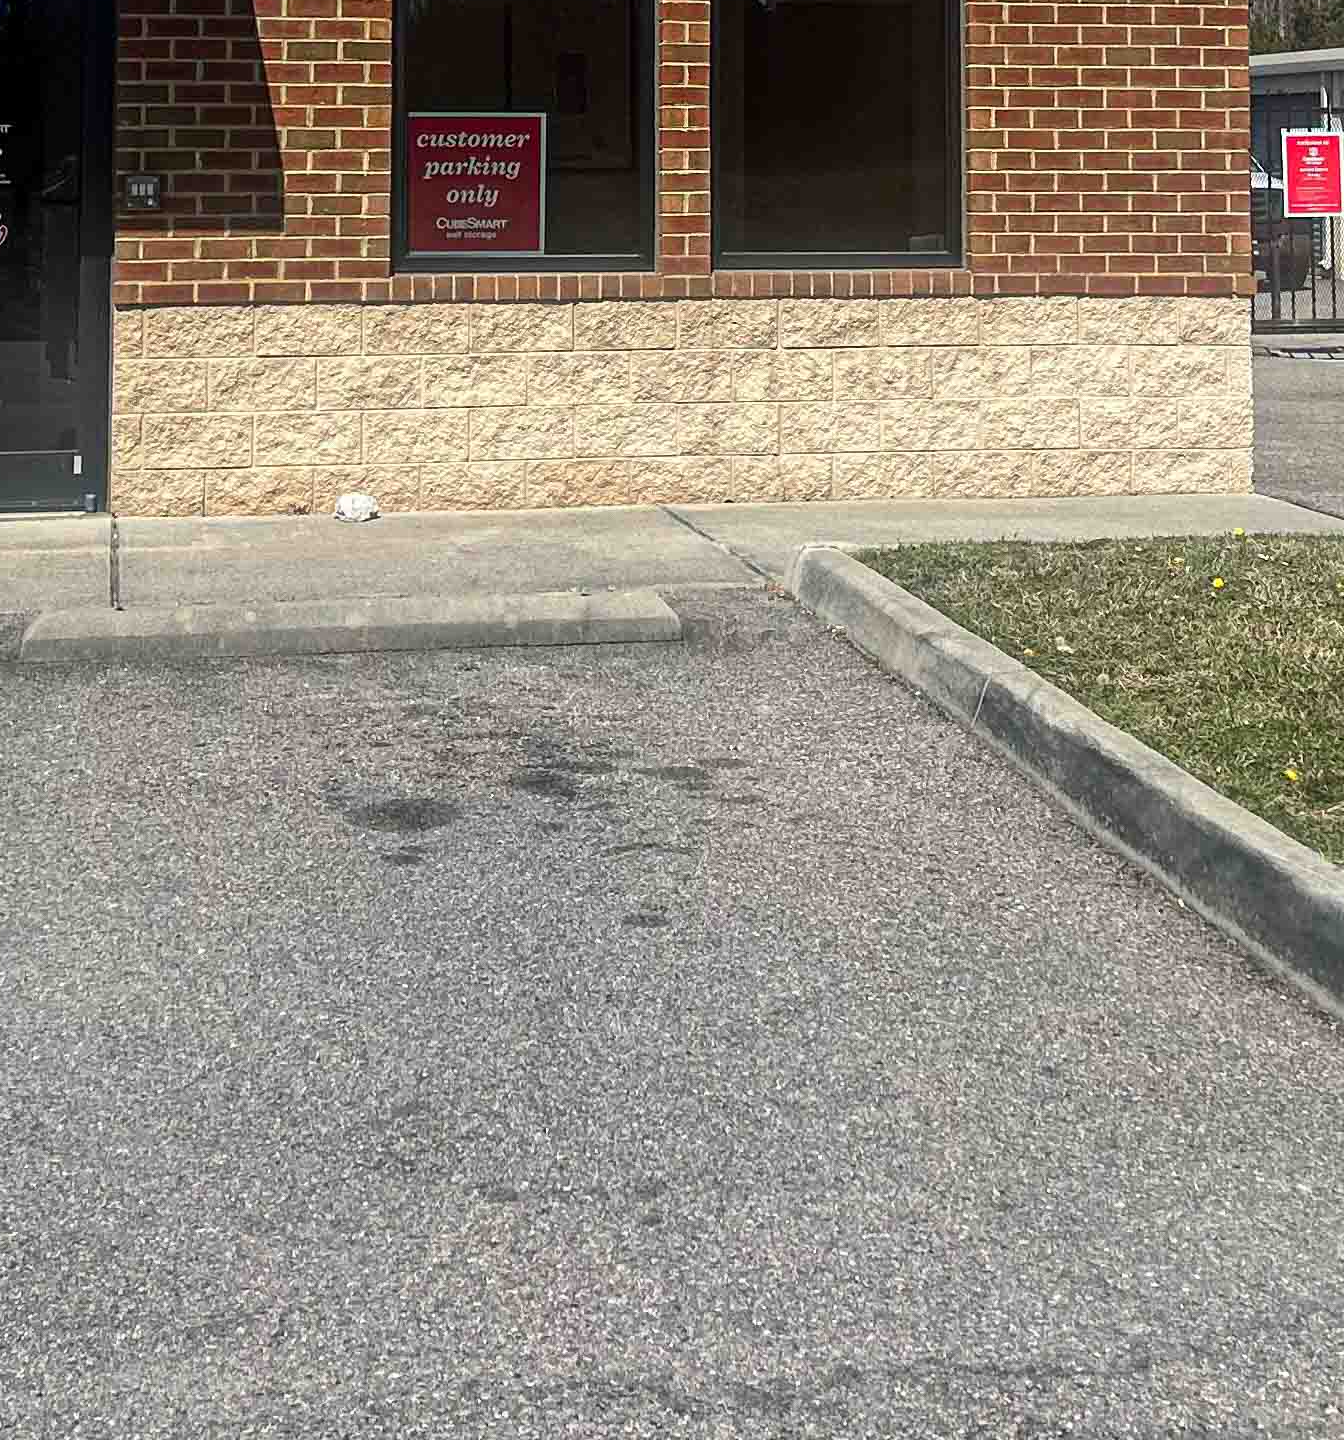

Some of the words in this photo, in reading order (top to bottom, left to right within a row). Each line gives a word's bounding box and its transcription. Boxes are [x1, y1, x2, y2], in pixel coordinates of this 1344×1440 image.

[416, 131, 530, 148] customer
[423, 155, 521, 179] parking
[446, 184, 500, 207] only
